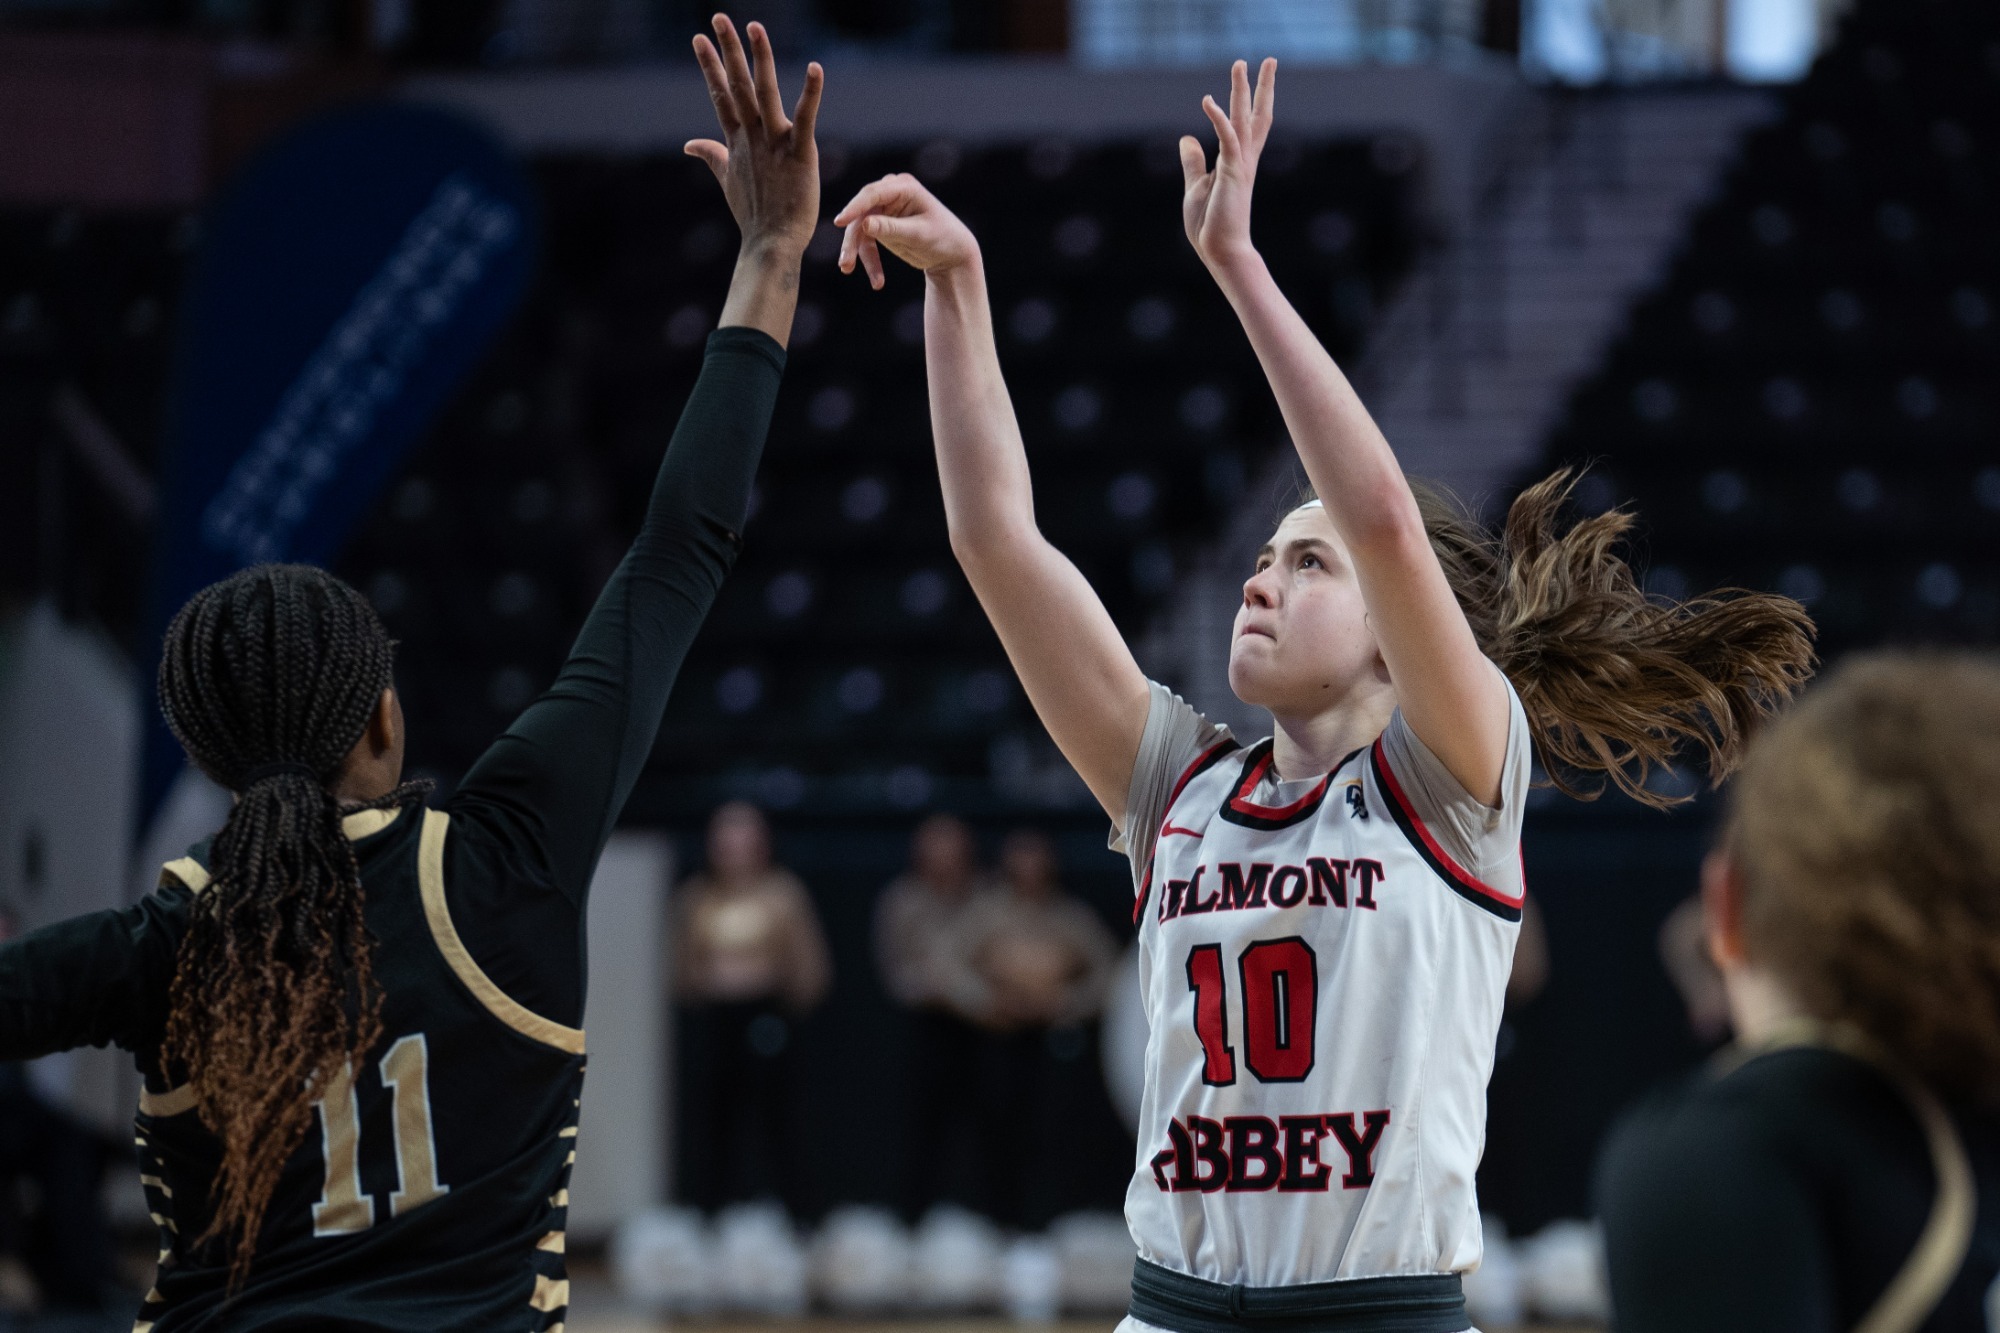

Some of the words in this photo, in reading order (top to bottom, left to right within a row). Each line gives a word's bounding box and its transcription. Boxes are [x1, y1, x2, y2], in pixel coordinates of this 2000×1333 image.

[1158, 857, 1385, 926] ELMONT
[1185, 936, 1318, 1087] 10
[306, 1033, 450, 1237] 11
